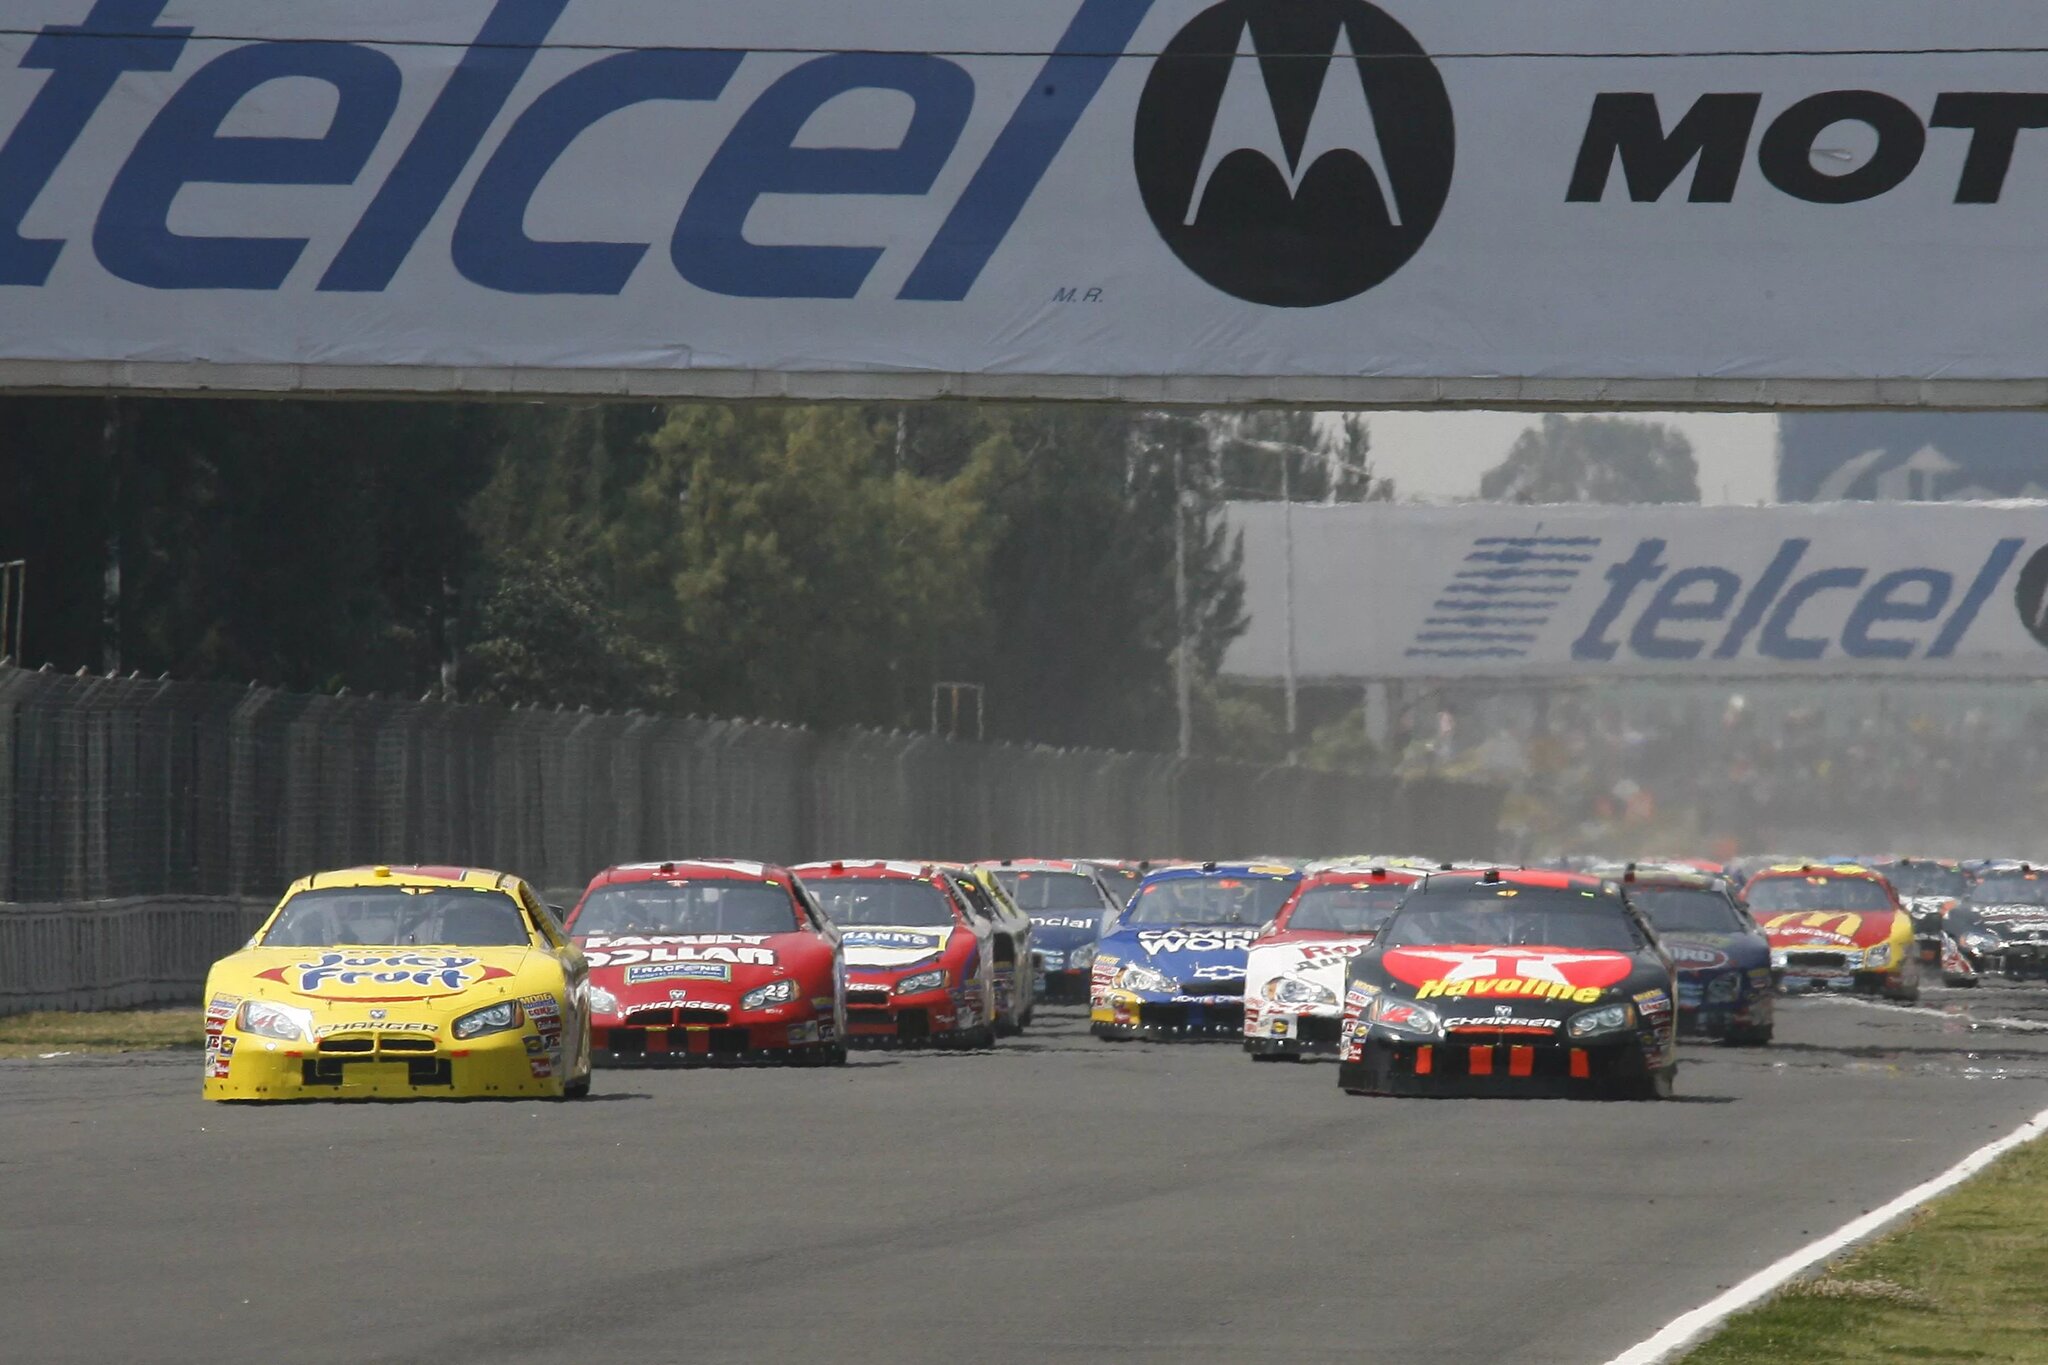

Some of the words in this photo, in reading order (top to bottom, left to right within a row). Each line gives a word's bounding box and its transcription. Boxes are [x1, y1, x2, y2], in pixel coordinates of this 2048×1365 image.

[0, 0, 1156, 300] telcel
[1571, 538, 2026, 661] telcel
[585, 935, 772, 948] FAMILY
[298, 953, 479, 970] Juicy
[582, 947, 775, 967] DOLLAR
[631, 964, 722, 974] TRACFONE
[301, 967, 472, 991] Fruit
[764, 985, 790, 998] 22
[1416, 977, 1602, 1003] Havoline
[624, 1000, 732, 1015] CHARGER
[314, 1021, 438, 1034] CHARGER
[1443, 1016, 1562, 1029] CHARGER
